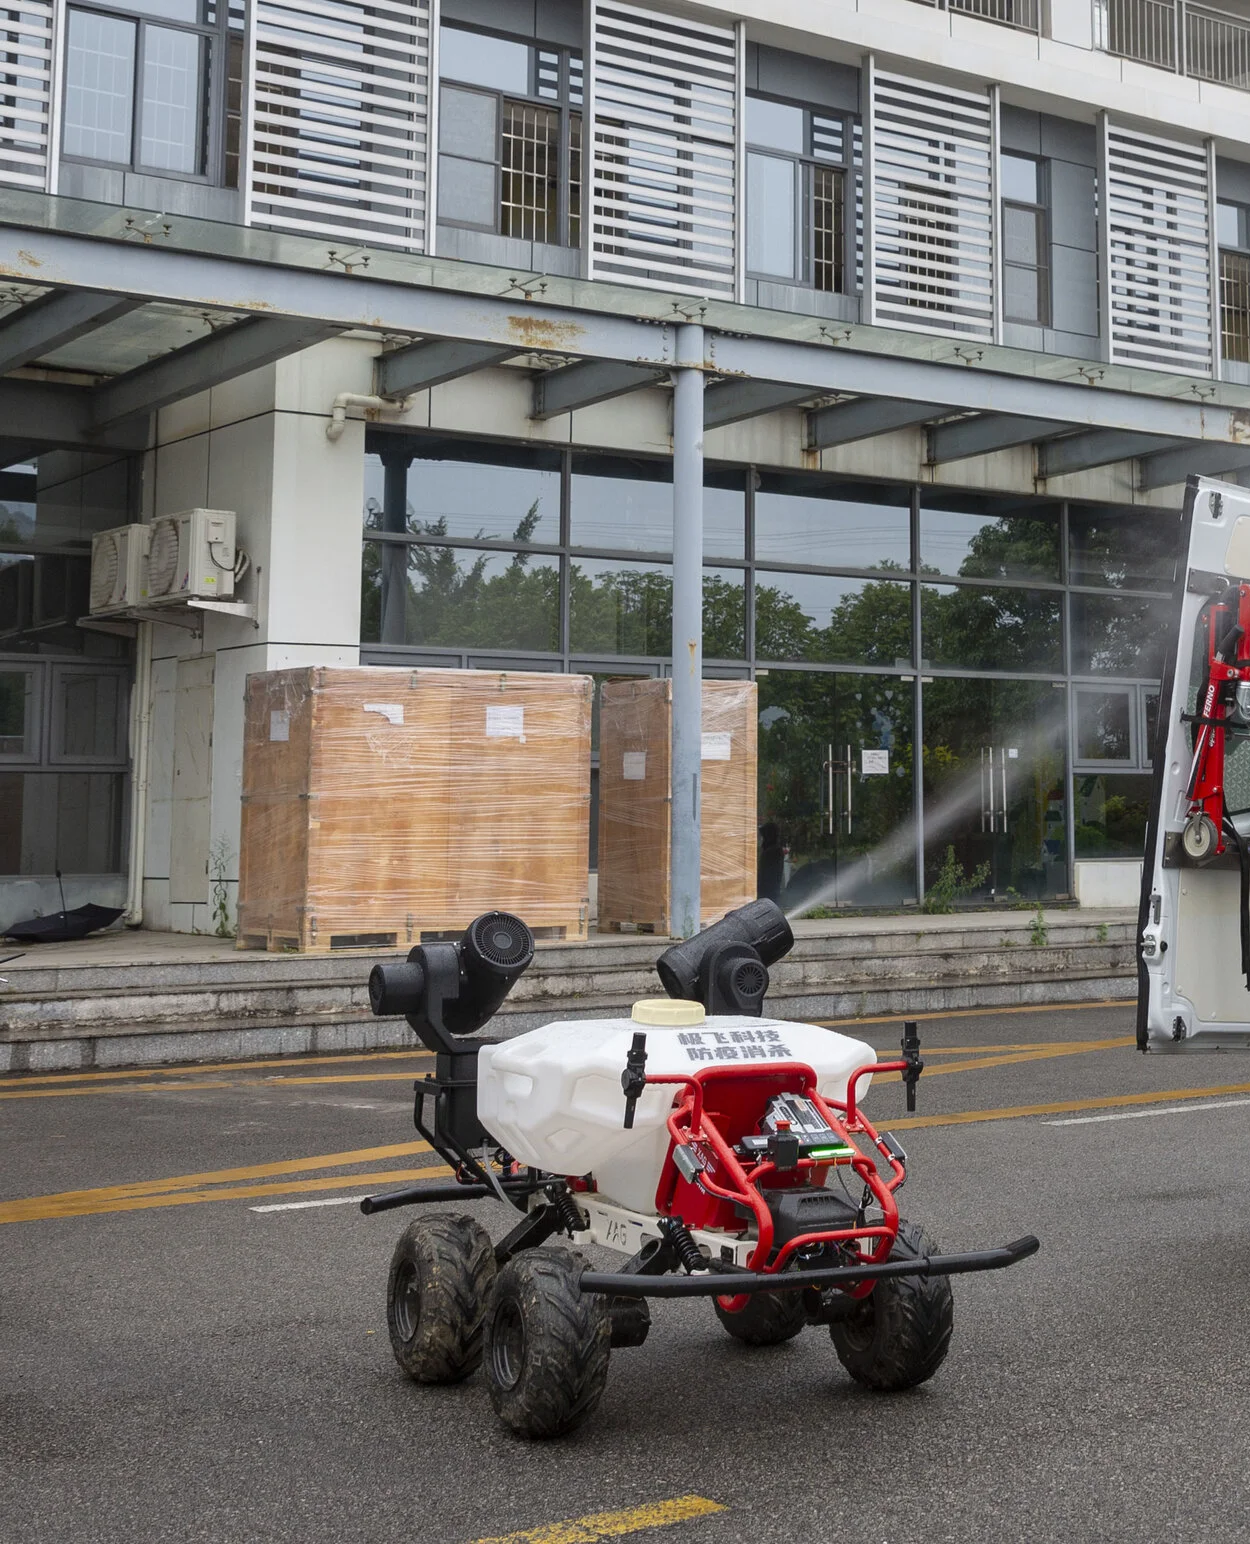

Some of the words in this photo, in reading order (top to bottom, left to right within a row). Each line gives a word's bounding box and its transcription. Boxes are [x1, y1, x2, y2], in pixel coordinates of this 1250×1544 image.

[1203, 684, 1216, 718] FERNO
[677, 1029, 781, 1046] 极飞科技
[686, 1043, 793, 1061] 防疫消杀
